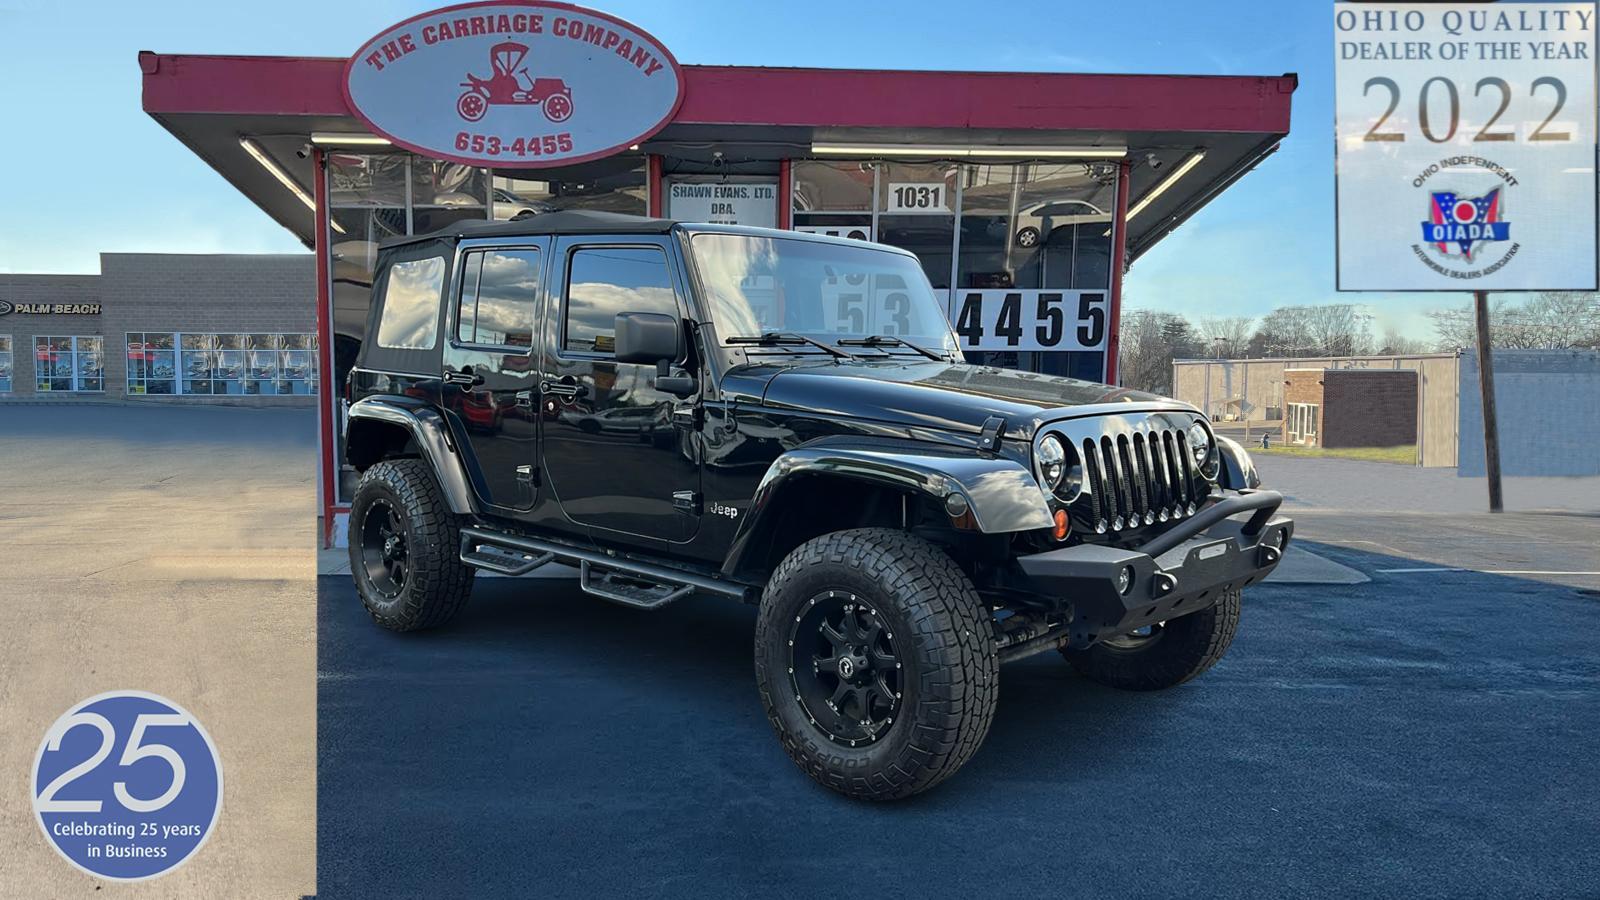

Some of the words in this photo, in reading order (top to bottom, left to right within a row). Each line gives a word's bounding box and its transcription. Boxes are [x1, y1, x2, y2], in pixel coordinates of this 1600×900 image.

[1336, 10, 1425, 31] OHIO
[1442, 10, 1593, 36] QUALITY
[366, 34, 416, 71] THE
[422, 15, 543, 45] CARRIAGE
[552, 17, 664, 77] COMPANY
[1340, 42, 1433, 60] DEALER
[1439, 42, 1470, 60] OF
[1475, 42, 1522, 60] THE
[1528, 42, 1589, 60] YEAR
[1363, 76, 1571, 143] 2022
[455, 132, 573, 156] 653-4455
[1412, 163, 1440, 188] OHIO
[1440, 155, 1519, 187] INDEPENDENT
[673, 185, 712, 198] SHAWN
[754, 187, 775, 199] LTD.
[894, 187, 940, 208] 1031
[1432, 223, 1495, 240] OIADA
[1411, 243, 1450, 277] AUTOMOBILE
[1450, 269, 1482, 280] DEALERS
[1482, 242, 1521, 276] ASSOCIATION
[14, 303, 51, 314] PALM
[956, 293, 1105, 347] 4455
[710, 501, 738, 519] Jeep
